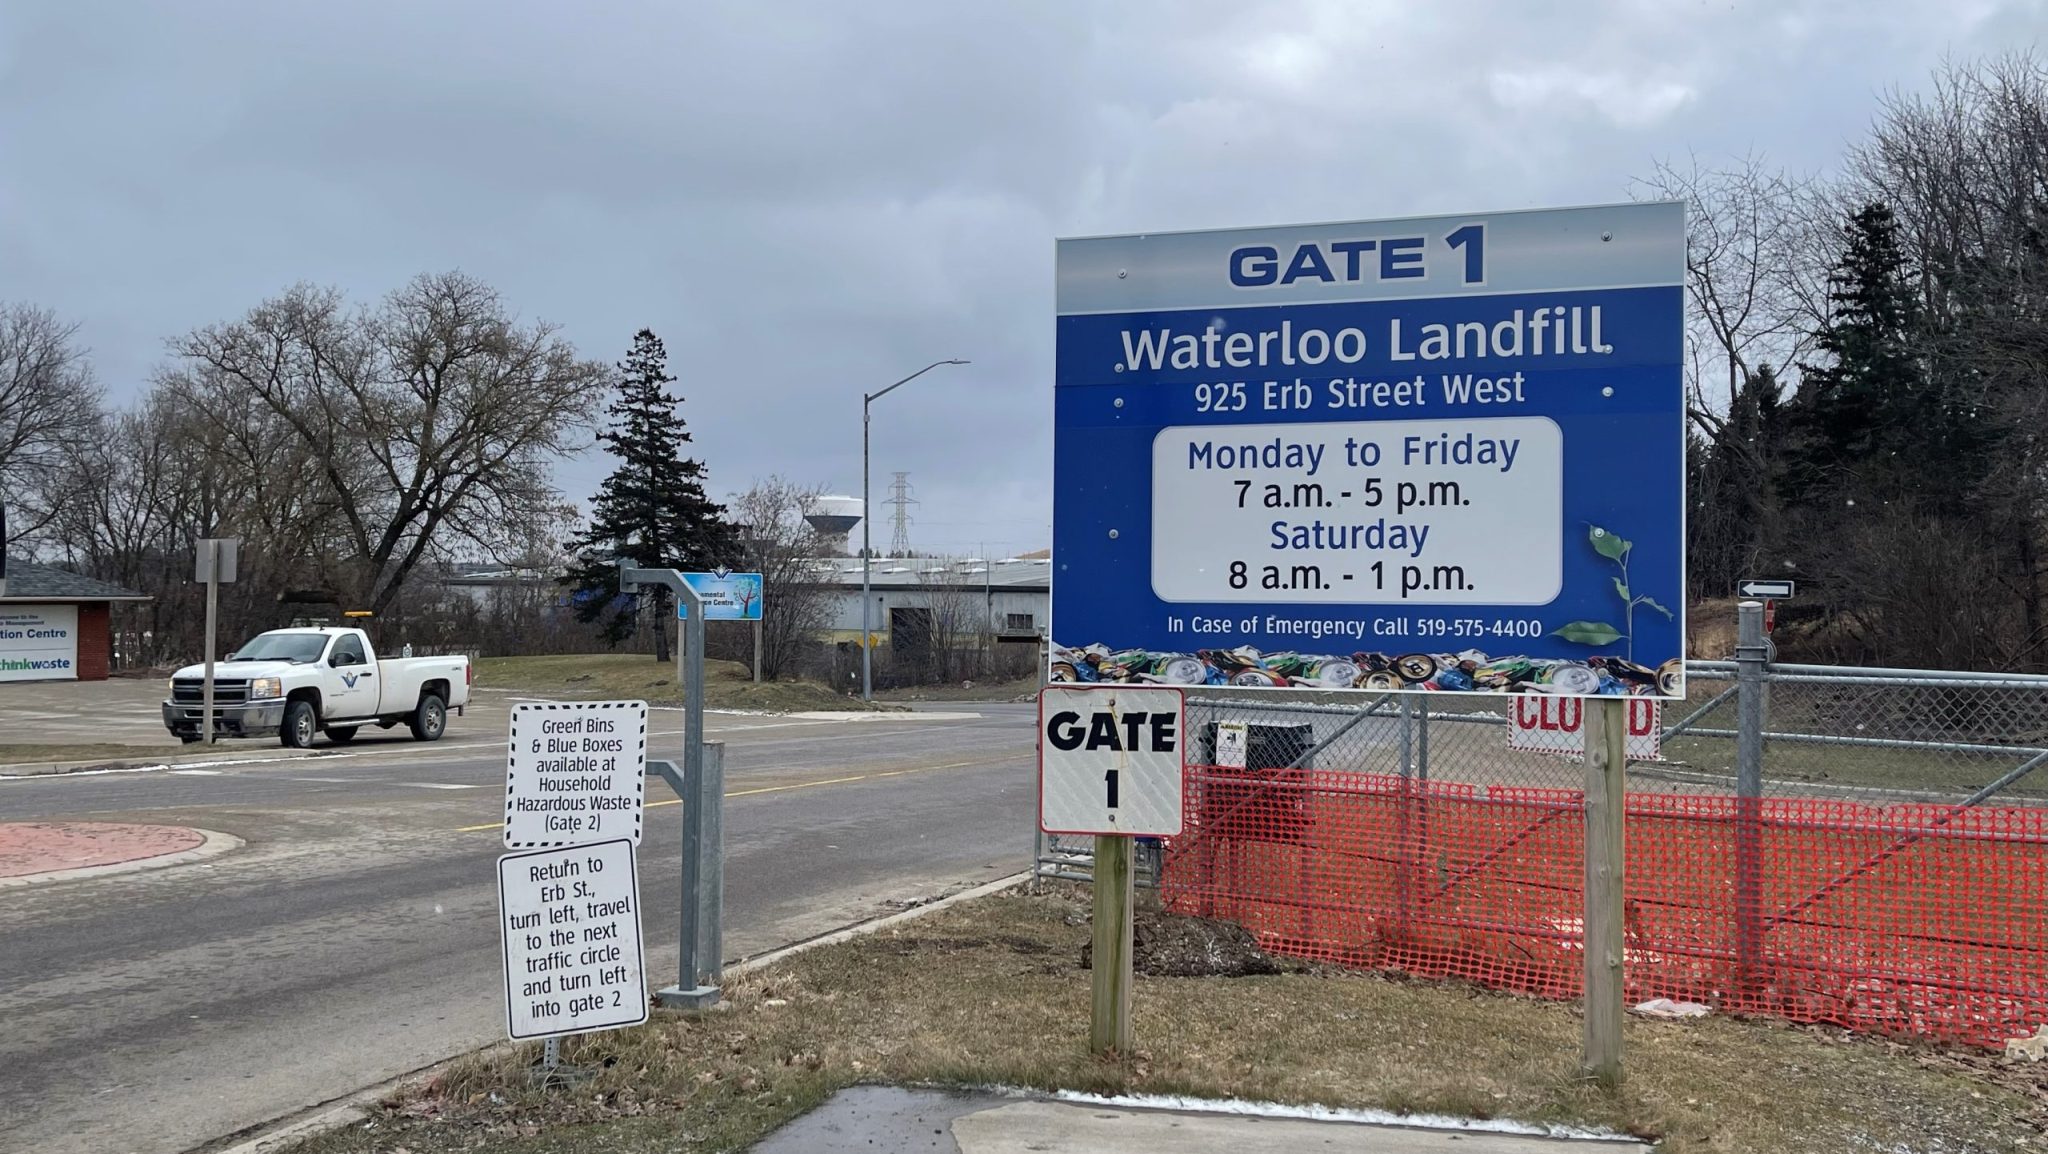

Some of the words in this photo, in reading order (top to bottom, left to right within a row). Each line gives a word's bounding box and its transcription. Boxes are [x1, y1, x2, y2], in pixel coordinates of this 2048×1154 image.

[1230, 237, 1424, 286] GATE
[1446, 226, 1483, 283] 1
[1122, 319, 1366, 372] Waterloo
[1391, 306, 1604, 360] Landfill
[1196, 383, 1246, 411] 925
[1264, 379, 1312, 409] Erb
[1328, 376, 1425, 408] Street
[1443, 372, 1524, 404] West
[1190, 438, 1324, 475] Monday
[1345, 438, 1380, 466] to
[1405, 433, 1520, 472] Friday
[1235, 480, 1251, 507] 7
[1264, 484, 1332, 507] a.m.
[1365, 478, 1382, 506] 5
[1398, 482, 1469, 514] p.m.
[1271, 519, 1429, 557] Saturday
[1230, 561, 1247, 589] 8
[1262, 566, 1329, 589] a.m.
[1371, 561, 1382, 589] 1
[1402, 566, 1473, 598] p.m.
[27, 629, 66, 638] Centre
[1169, 617, 1183, 632] In
[1192, 617, 1231, 633] Case
[1241, 616, 1257, 633] of
[1267, 615, 1365, 639] Emergency
[1374, 618, 1408, 635] Call
[1418, 619, 1541, 637] 519-575-4400
[543, 718, 582, 734] Green
[587, 718, 614, 732] Bins
[1516, 697, 1653, 736] CLOD
[532, 739, 540, 753] &
[548, 738, 577, 752] Blue
[583, 738, 622, 752] Boxes
[1048, 712, 1176, 752] GATE
[537, 757, 597, 772] available
[603, 757, 615, 771] at
[540, 775, 610, 791] Household
[1105, 770, 1118, 808] 1
[517, 796, 585, 811] Hazardous
[590, 795, 631, 810] Waste
[546, 815, 581, 832] (Gate
[589, 814, 600, 832] 2)
[530, 859, 580, 882] Return
[588, 858, 602, 873] to
[542, 884, 565, 902] Erb
[574, 881, 595, 897] St.,
[510, 914, 540, 929] turn
[550, 905, 578, 924] left,
[588, 896, 630, 918] travel
[527, 935, 541, 950] to
[550, 929, 574, 946] the
[584, 922, 617, 942] next
[527, 951, 572, 973] traffic
[581, 945, 620, 966] circle
[524, 976, 551, 996] and
[560, 975, 590, 991] turn
[600, 966, 626, 985] left
[532, 1001, 560, 1018] into
[570, 995, 603, 1017] gate
[613, 991, 621, 1006] 2
